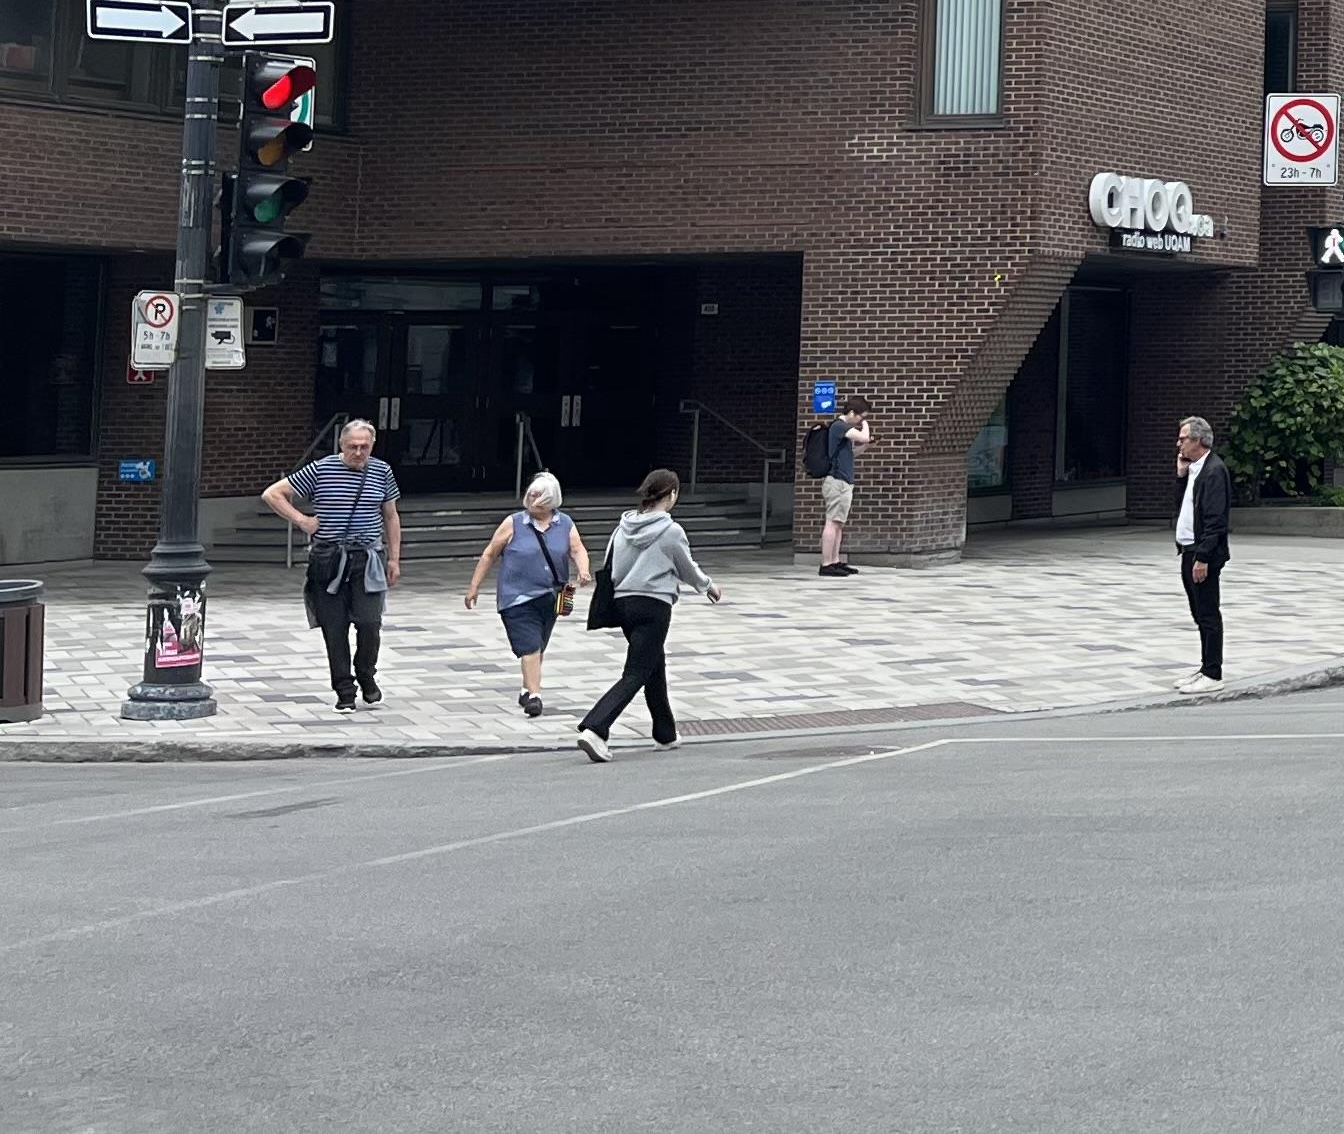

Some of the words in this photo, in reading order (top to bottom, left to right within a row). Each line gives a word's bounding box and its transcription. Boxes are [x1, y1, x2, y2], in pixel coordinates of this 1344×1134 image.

[1280, 167, 1299, 178] 23h
[1310, 167, 1322, 178] 7h
[1121, 231, 1146, 248] radio
[1146, 234, 1164, 250] web
[1164, 234, 1191, 252] UQAM
[160, 330, 171, 341] 7h
